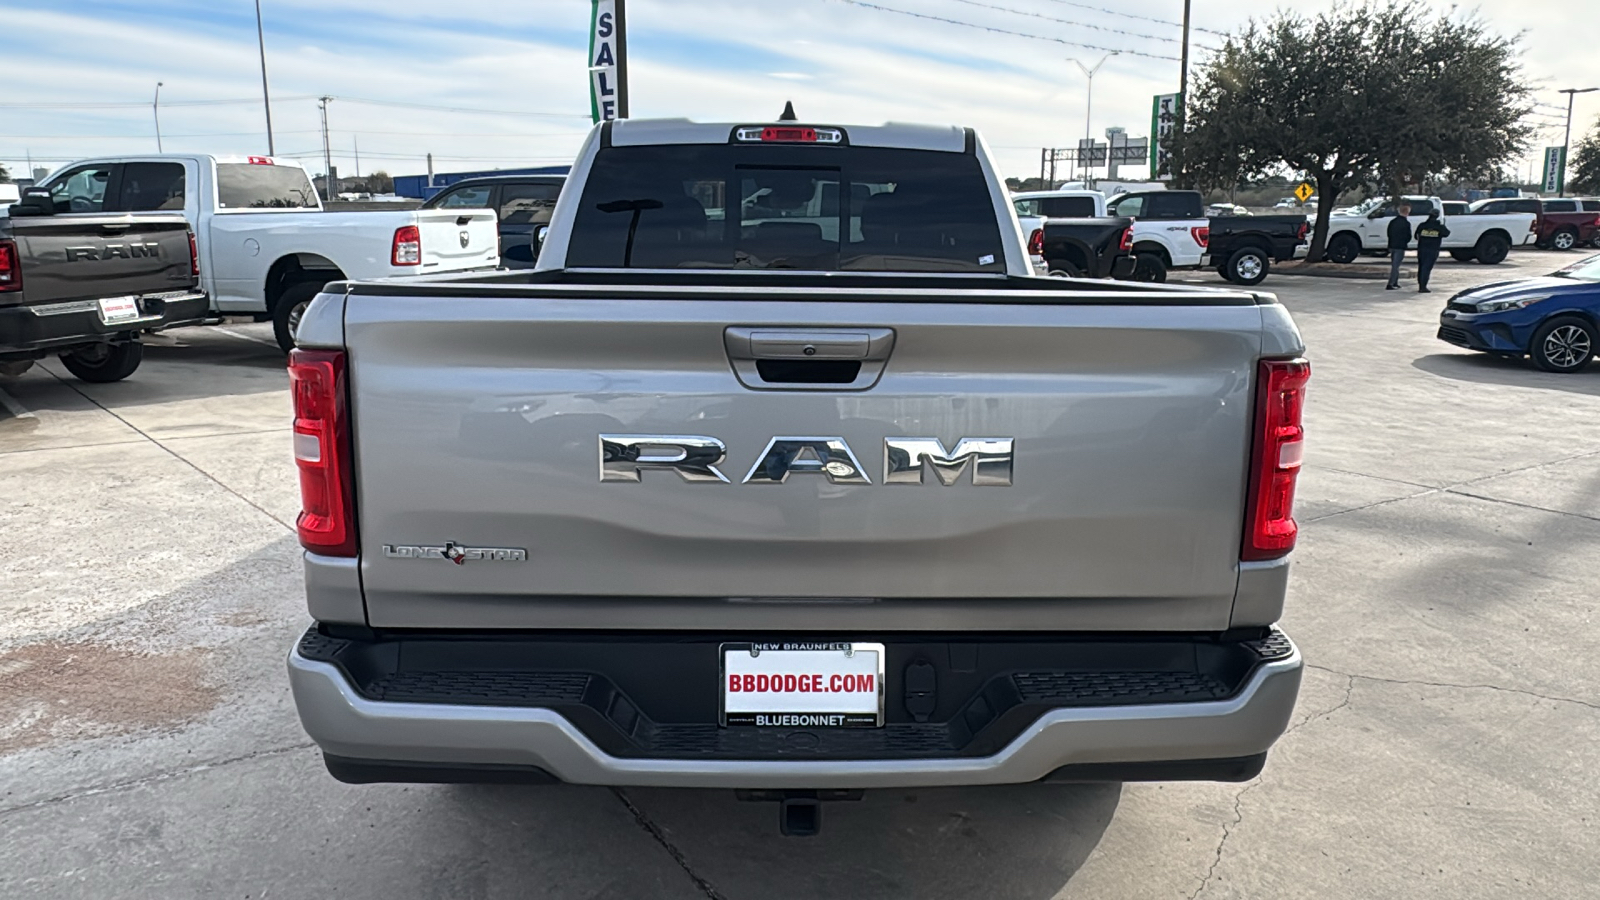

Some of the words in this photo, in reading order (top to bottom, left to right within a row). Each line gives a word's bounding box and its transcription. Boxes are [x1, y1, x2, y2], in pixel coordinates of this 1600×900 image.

[595, 12, 615, 120] SALE
[65, 242, 159, 262] RAM
[598, 433, 1016, 486] RAM
[382, 545, 446, 559] LONE
[463, 547, 527, 561] STAR
[729, 674, 874, 693] BBDODGE.COM
[756, 715, 845, 726] BLUEBONNET
